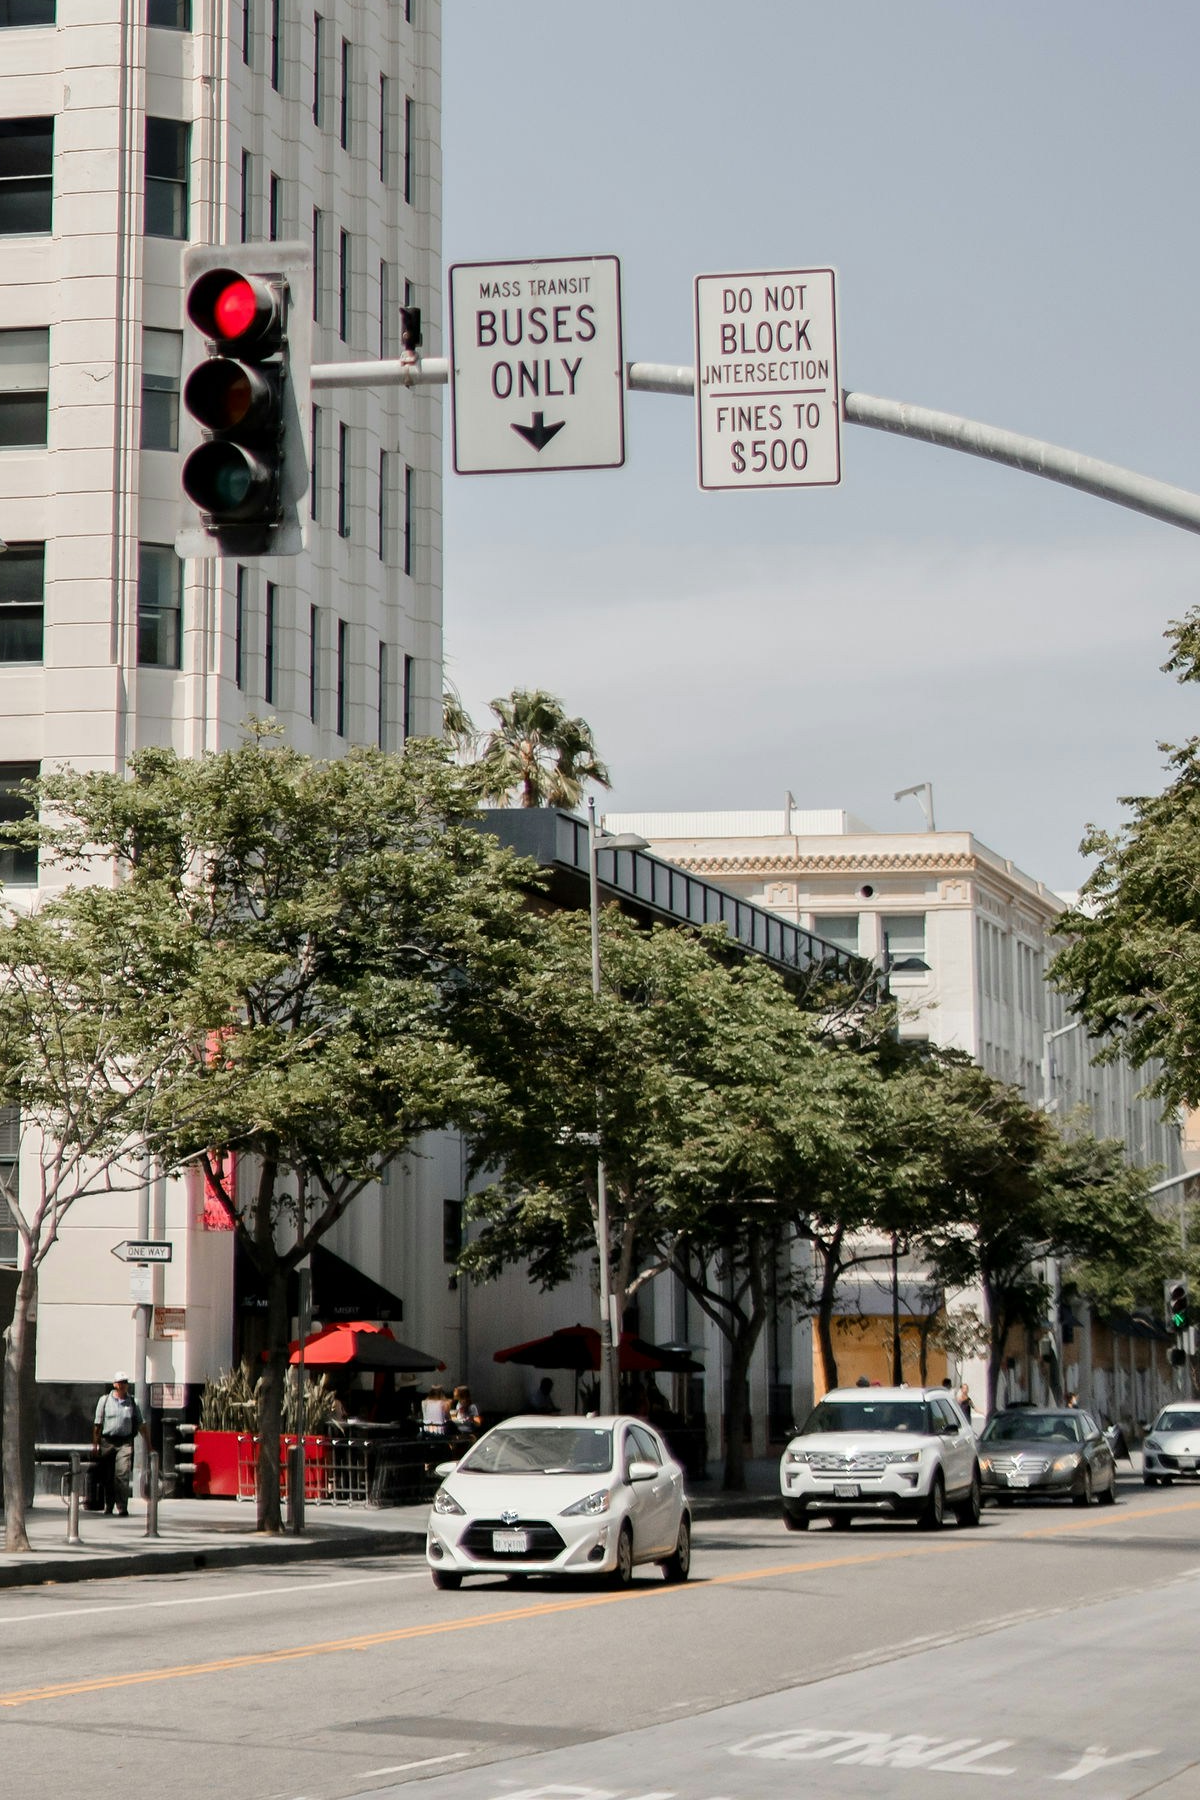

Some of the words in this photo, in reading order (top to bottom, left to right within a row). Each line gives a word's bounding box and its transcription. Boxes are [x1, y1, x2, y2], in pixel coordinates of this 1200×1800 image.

[479, 279, 521, 299] MASS
[529, 276, 591, 296] TRANSIT
[722, 287, 753, 315] DO
[764, 284, 807, 312] NOT
[475, 303, 597, 348] BUSES
[720, 319, 812, 355] BLOCK
[490, 356, 583, 400] ONLY
[705, 359, 829, 385] INTERSECTION
[716, 405, 782, 433] FINES
[793, 402, 820, 429] TO
[731, 438, 809, 474] $500
[128, 1247, 145, 1256] ONE
[147, 1248, 166, 1257] WAY
